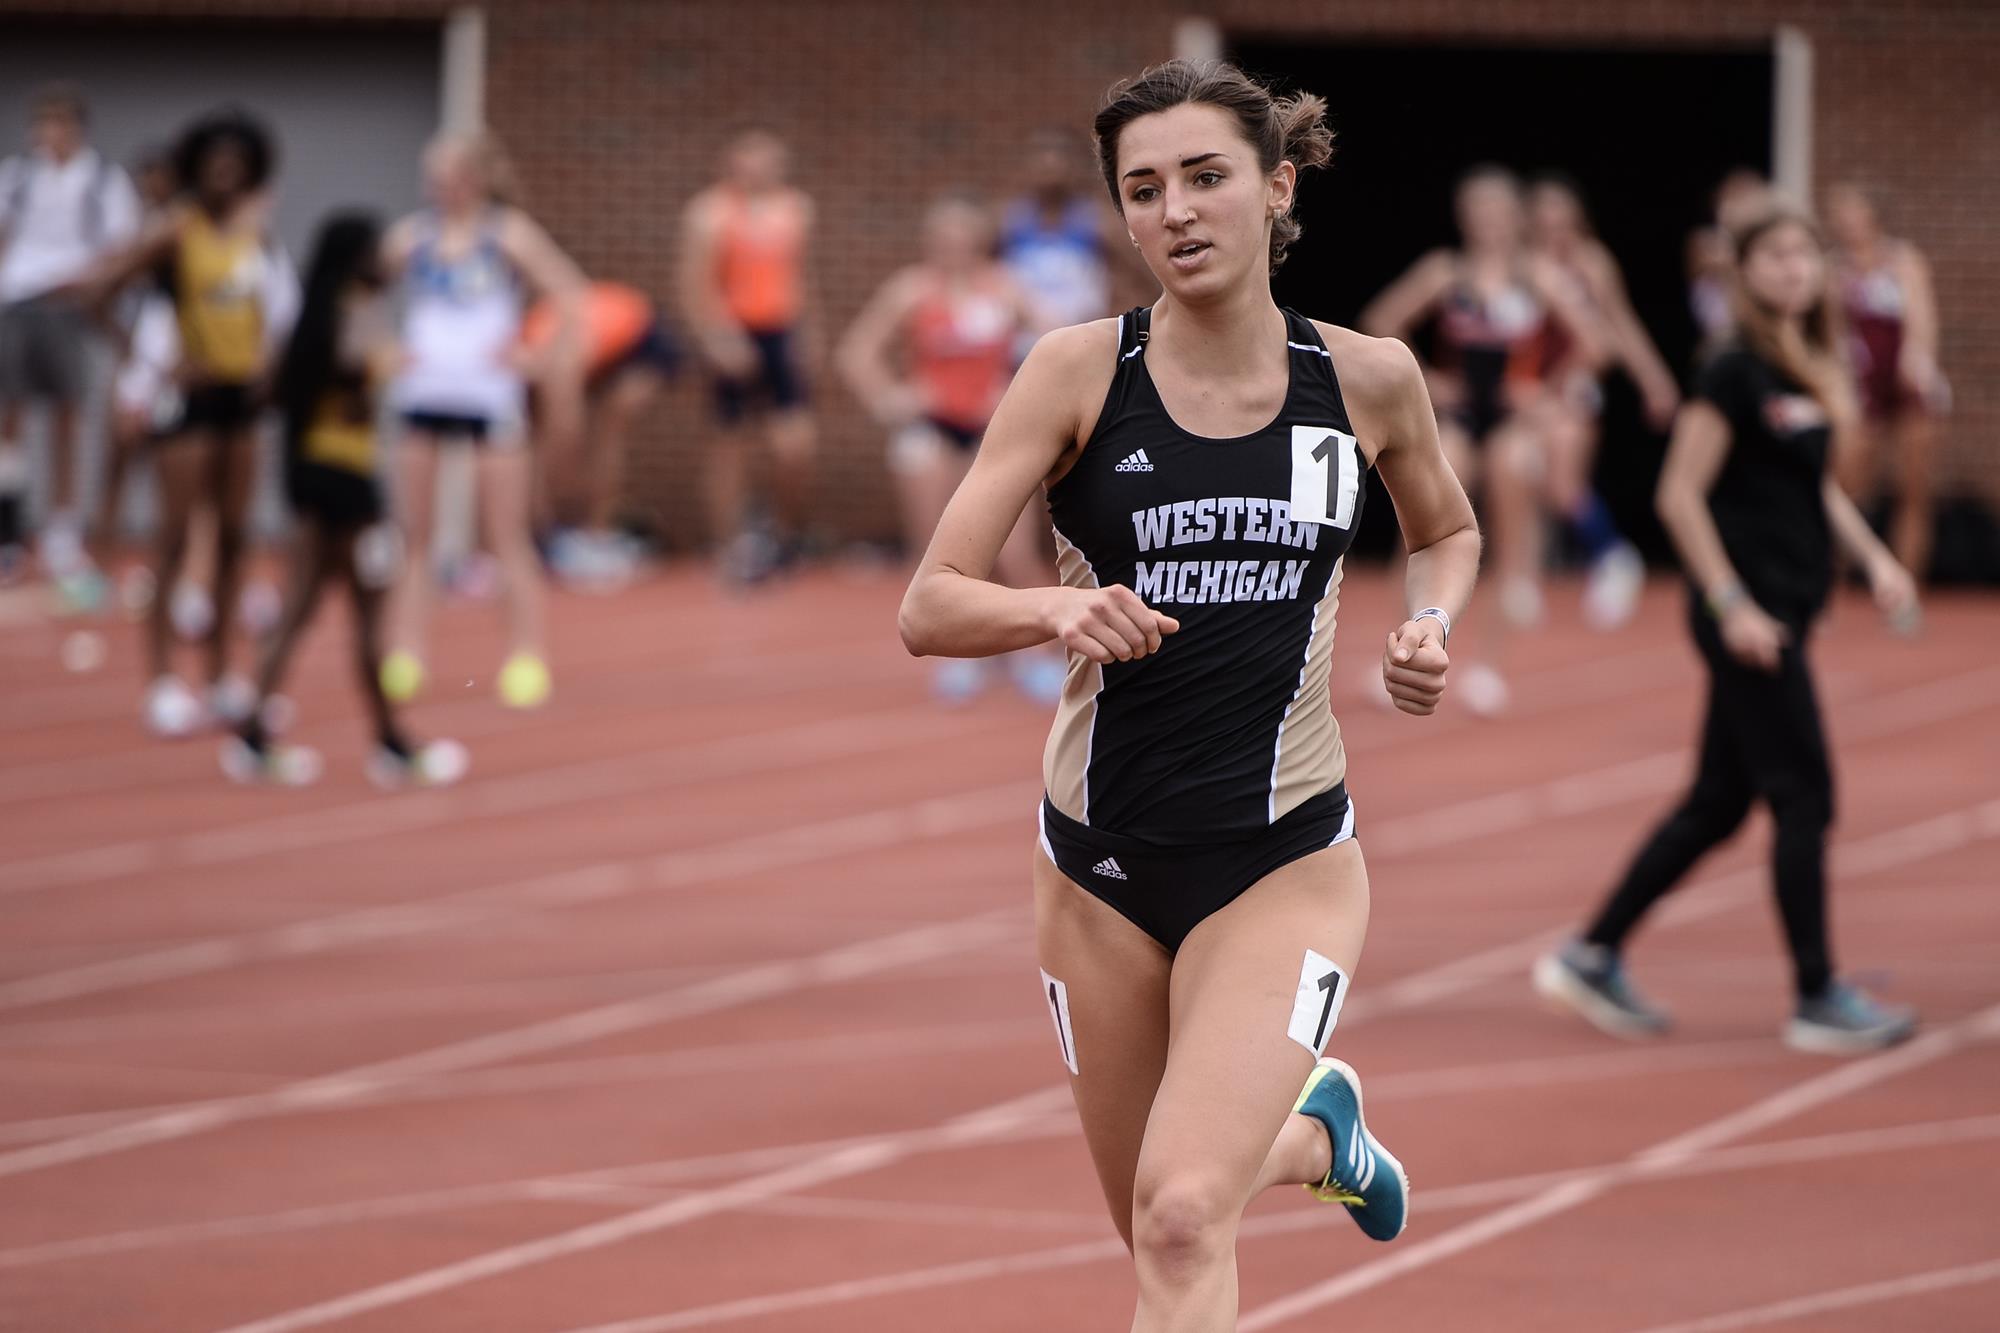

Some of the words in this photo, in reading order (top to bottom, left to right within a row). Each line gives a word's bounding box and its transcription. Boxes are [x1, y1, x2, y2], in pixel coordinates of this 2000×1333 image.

[1115, 462, 1154, 472] adidas
[1311, 435, 1339, 520] 1
[1132, 497, 1319, 551] WESTERN
[1135, 560, 1310, 603] MICHIGAN
[1092, 866, 1128, 880] adidas
[1049, 982, 1070, 1062] 1
[1313, 970, 1340, 1051] 1
